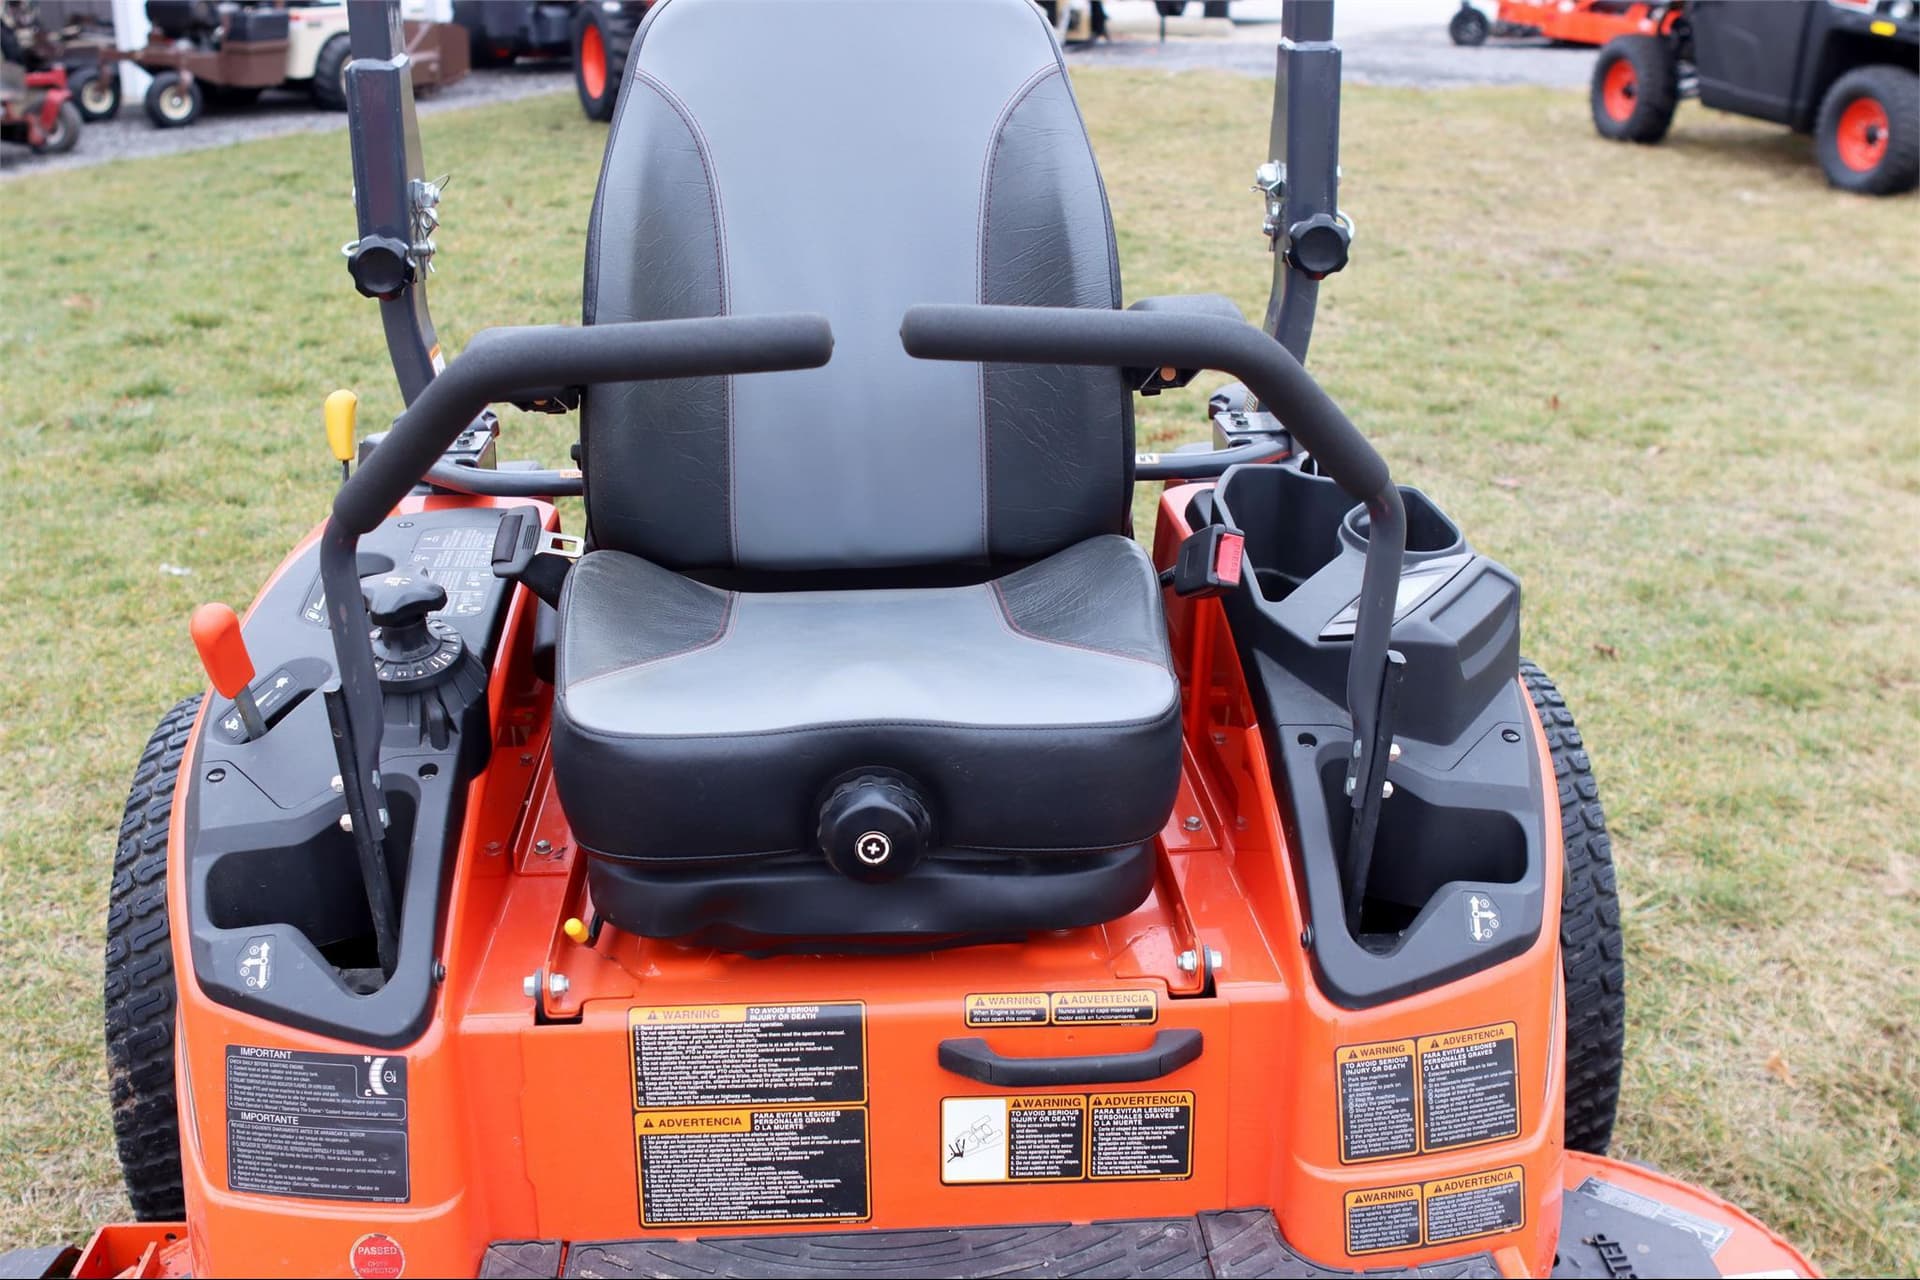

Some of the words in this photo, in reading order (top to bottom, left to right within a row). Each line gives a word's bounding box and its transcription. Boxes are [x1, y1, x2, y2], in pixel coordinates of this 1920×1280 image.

[988, 996, 1040, 1005] WARNING
[1071, 994, 1149, 1003] ADVERTENCIA
[663, 1009, 719, 1019] WARNING
[1443, 1028, 1504, 1045] ADVERTENCIA
[240, 1048, 292, 1059] IMPORTANT
[1359, 1044, 1404, 1056] WARNING
[1423, 1051, 1440, 1059] PARA
[1442, 1047, 1464, 1056] EVITAR
[1466, 1041, 1496, 1052] LESIONES
[1378, 1056, 1408, 1064] SERIOUS
[1423, 1053, 1466, 1065] PERSONALES
[1467, 1048, 1492, 1057] GRAVES
[1345, 1067, 1370, 1075] INJURY
[1383, 1063, 1405, 1071] DEATH
[1441, 1059, 1466, 1068] MUERTE
[364, 1088, 372, 1096] C
[1023, 1097, 1080, 1108] WARNING
[1105, 1095, 1187, 1105] ADVERTENCIA
[240, 1112, 298, 1125] IMPORTANTE
[658, 1115, 741, 1128] ADVERTENCIA
[1444, 1170, 1512, 1191] ADVERTENCIA
[1362, 1188, 1413, 1202] WARNING
[358, 1246, 398, 1256] PASSED
